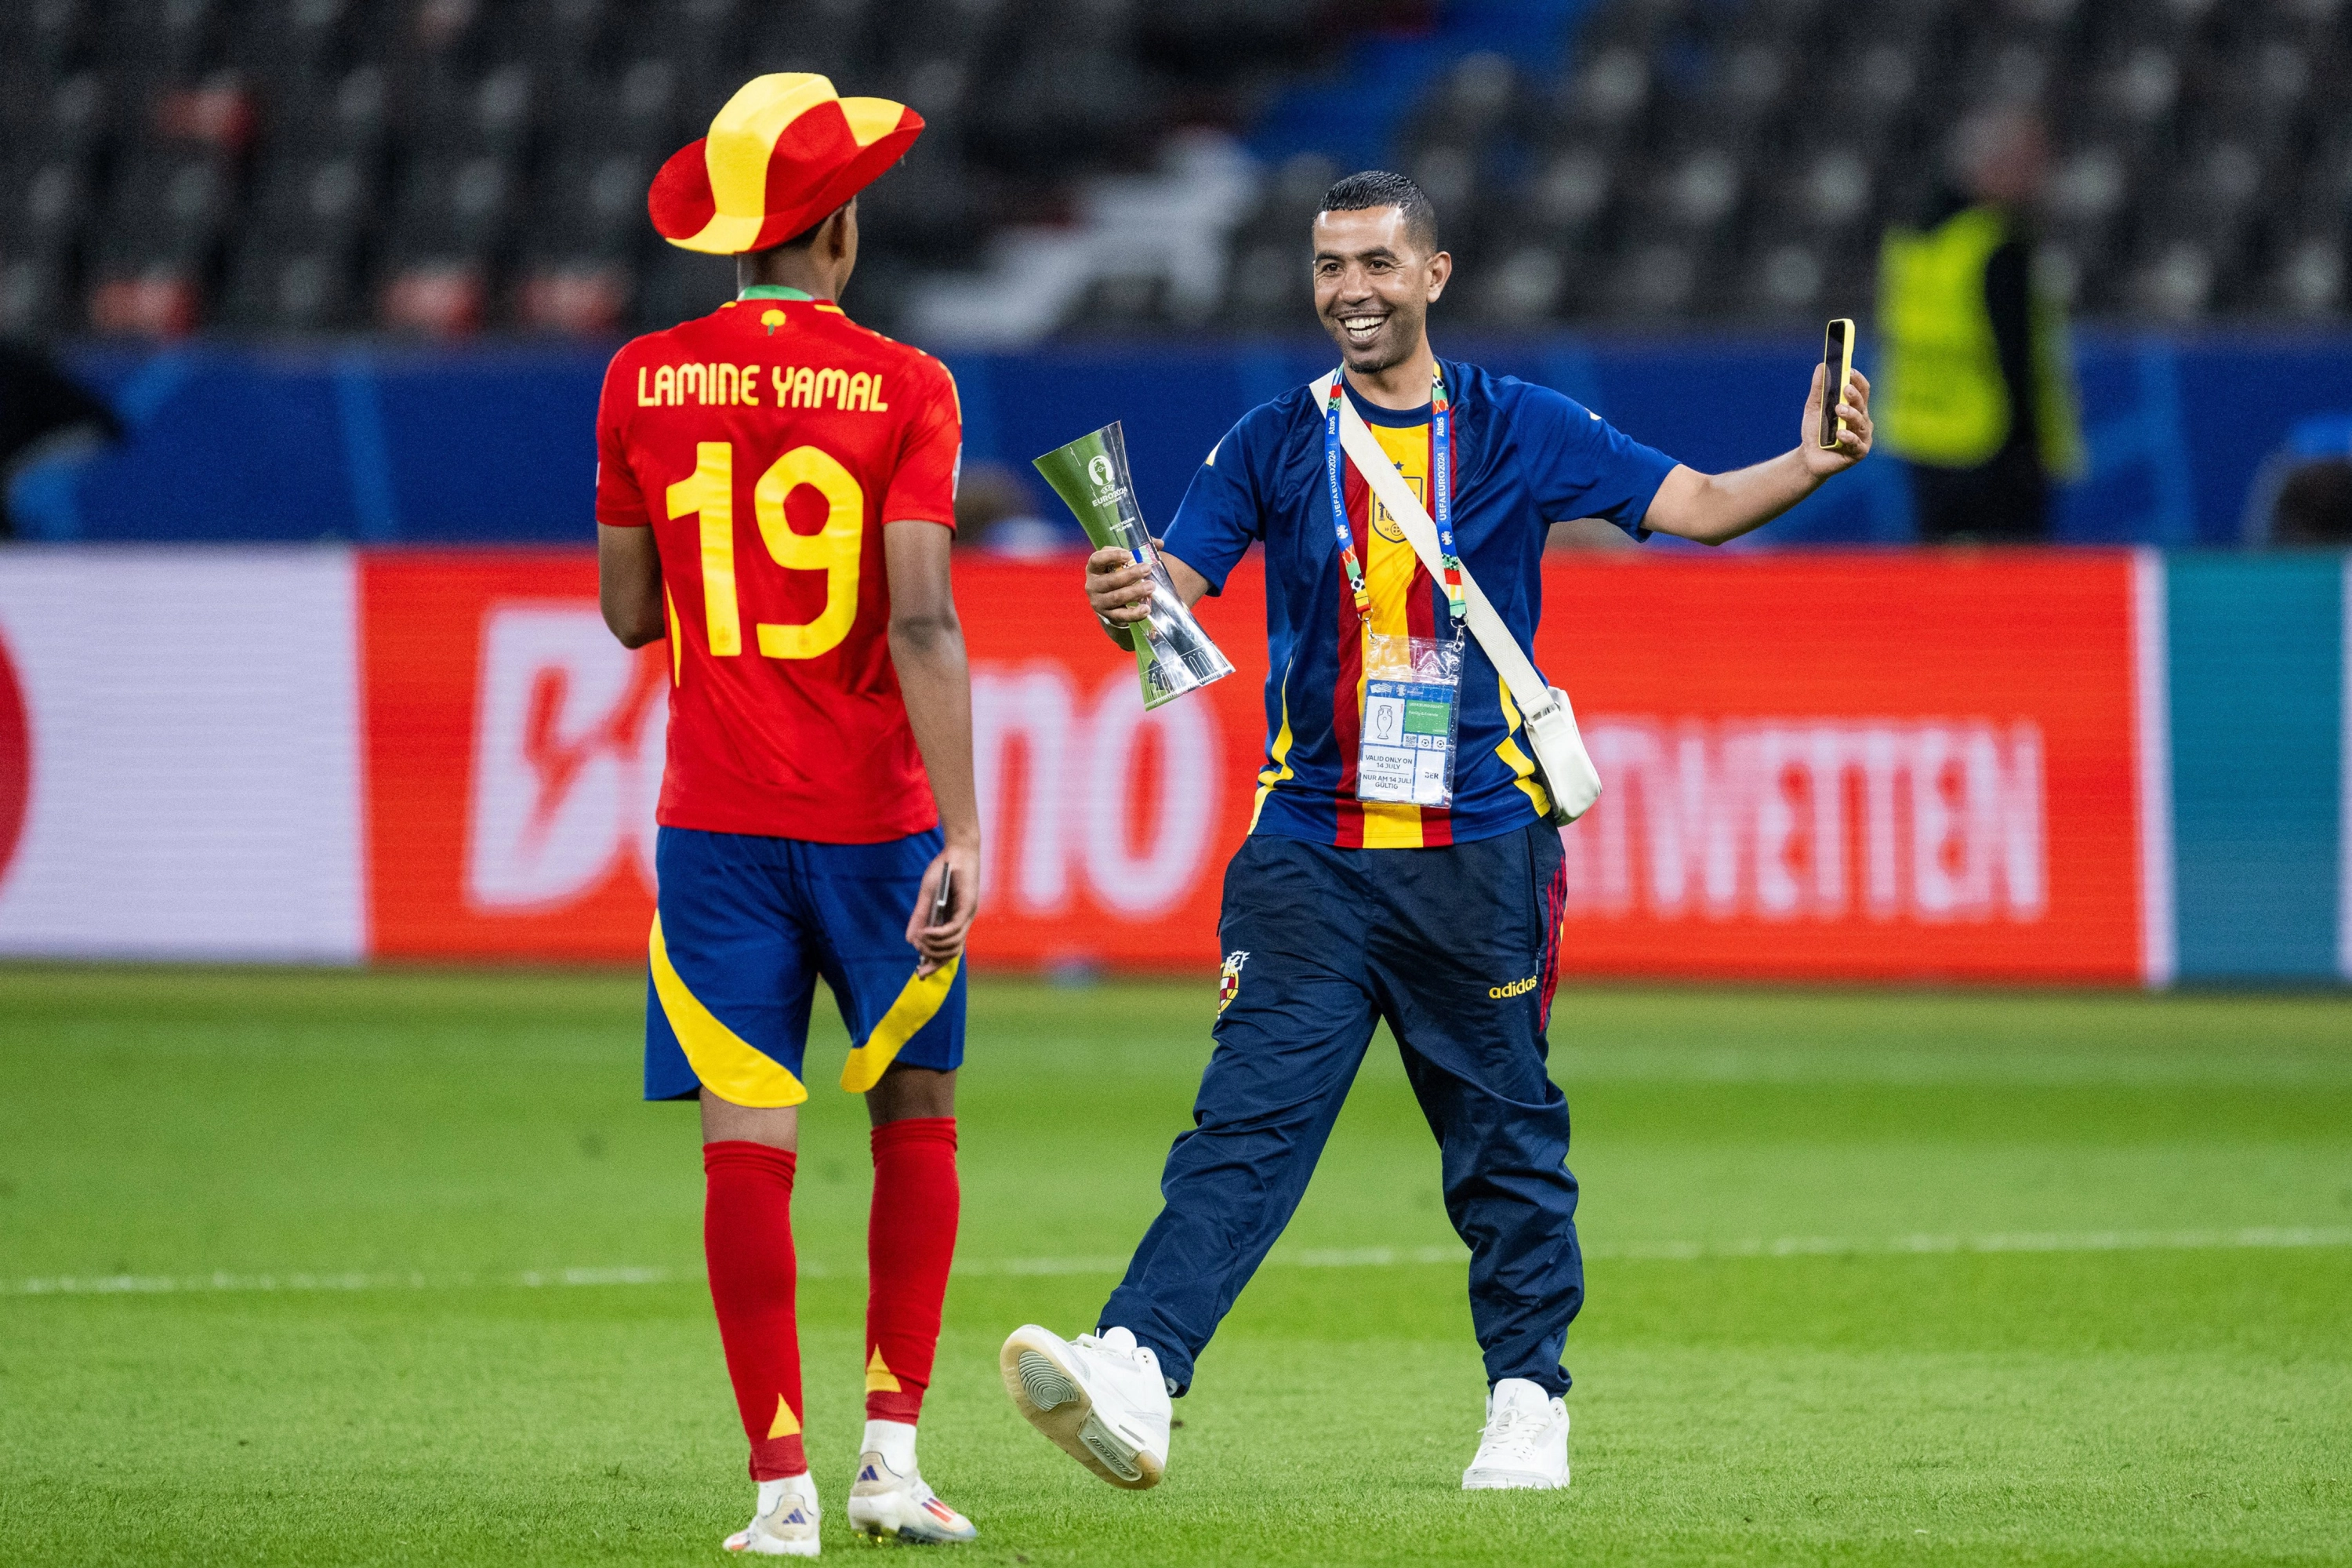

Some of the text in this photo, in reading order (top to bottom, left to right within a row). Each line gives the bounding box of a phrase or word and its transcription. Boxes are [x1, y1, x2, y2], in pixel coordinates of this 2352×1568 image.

[637, 362, 888, 412] LAMINE YAMAL
[666, 441, 863, 659] 19
[1375, 781, 1399, 789] GÜLTIG
[1489, 975, 1537, 1000] adidas
